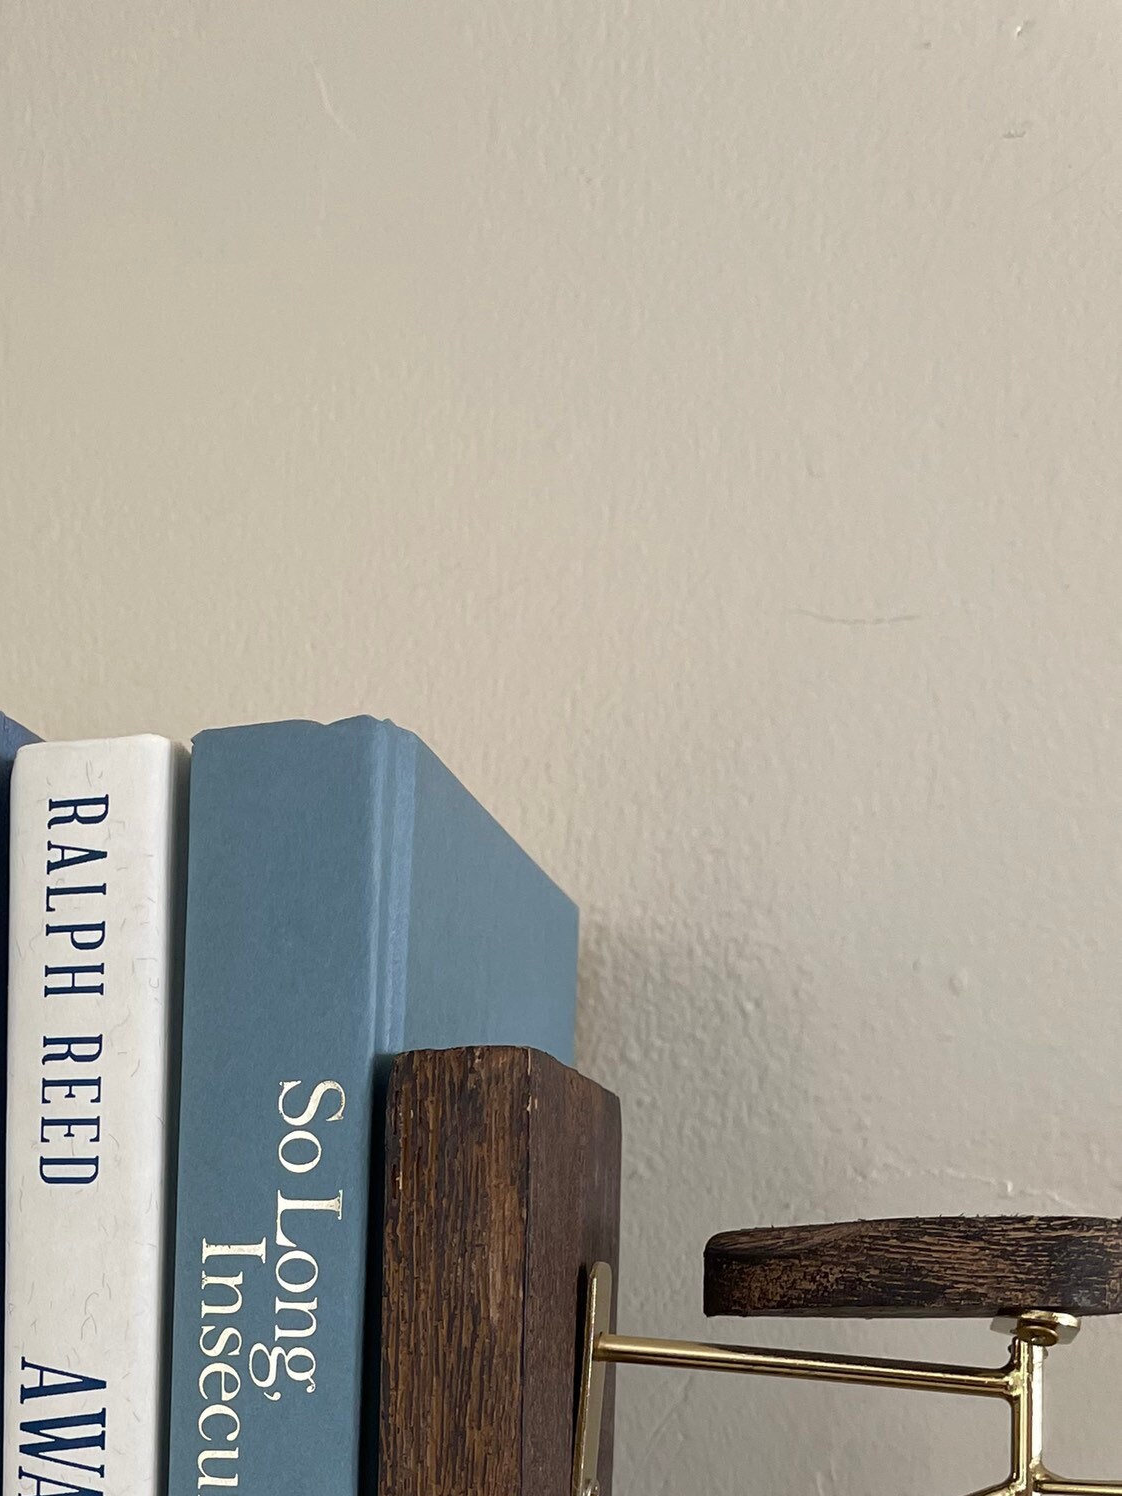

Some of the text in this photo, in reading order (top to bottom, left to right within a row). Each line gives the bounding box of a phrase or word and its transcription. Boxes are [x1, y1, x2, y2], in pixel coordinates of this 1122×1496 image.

[39, 793, 110, 1187] RALPH REED
[248, 1079, 346, 1401] So Long,
